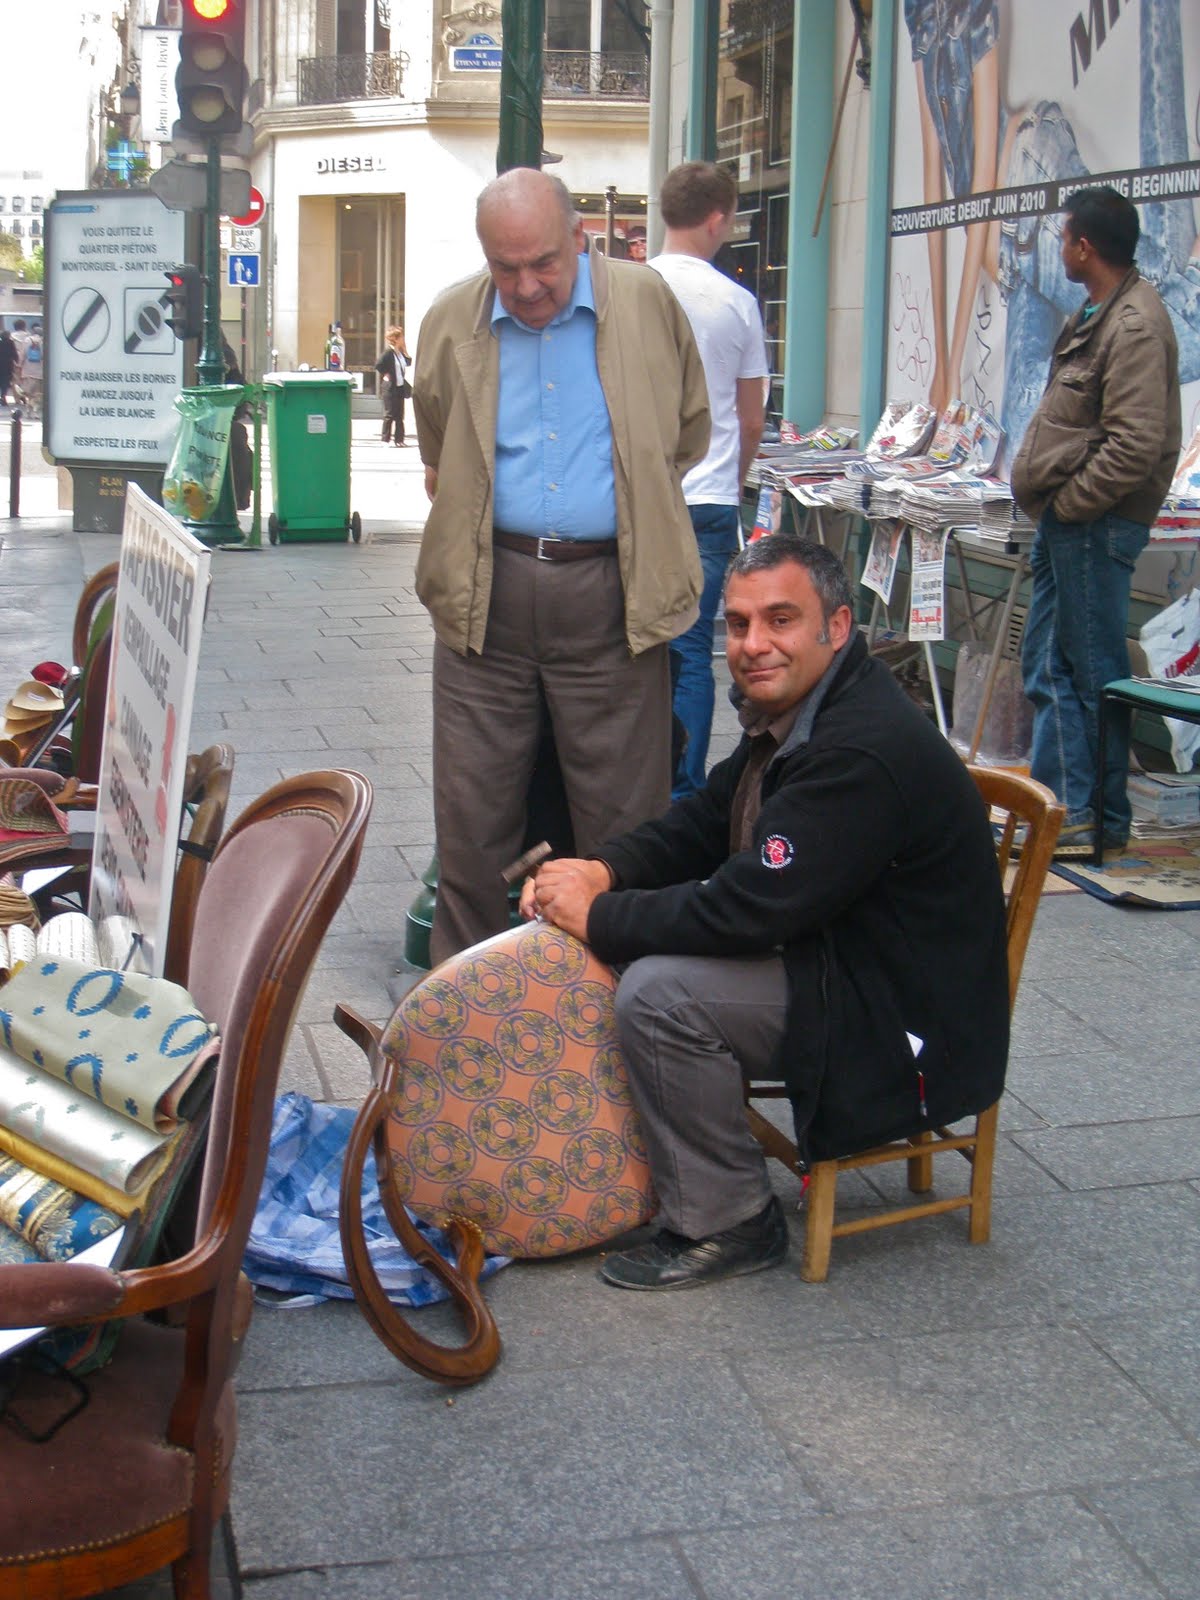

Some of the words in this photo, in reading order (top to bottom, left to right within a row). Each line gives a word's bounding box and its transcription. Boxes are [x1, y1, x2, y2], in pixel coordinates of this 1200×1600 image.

[155, 36, 169, 68] David
[317, 156, 387, 174] DIESEL
[890, 204, 956, 233] REOUVERTURE
[957, 197, 991, 222] DEBUT
[992, 193, 1018, 216] JUIN
[1019, 189, 1047, 212] 2010
[82, 226, 105, 237] VOUS
[106, 226, 141, 237] QUITTEZ
[143, 226, 154, 236] LE
[235, 229, 255, 237] SAUF
[79, 244, 119, 254] QUARTIER
[121, 242, 157, 254] PIÉTONS
[61, 261, 118, 272] MONTORGUEIL
[124, 262, 150, 272] SAINT
[151, 262, 177, 272] DENIS
[60, 371, 82, 382] POUR
[84, 372, 123, 382] ABAISSER
[124, 373, 141, 384] LES
[142, 373, 176, 384] BORNES
[81, 389, 117, 400] AVANCEZ
[79, 406, 91, 416] LA
[92, 406, 116, 417] LIGNE
[117, 407, 156, 419] BLANCHE
[73, 436, 119, 448] RESPECTEZ
[121, 438, 137, 448] LES
[138, 439, 158, 450] FEUX
[100, 475, 123, 487] PLAN
[122, 502, 196, 657] TAPISSIER
